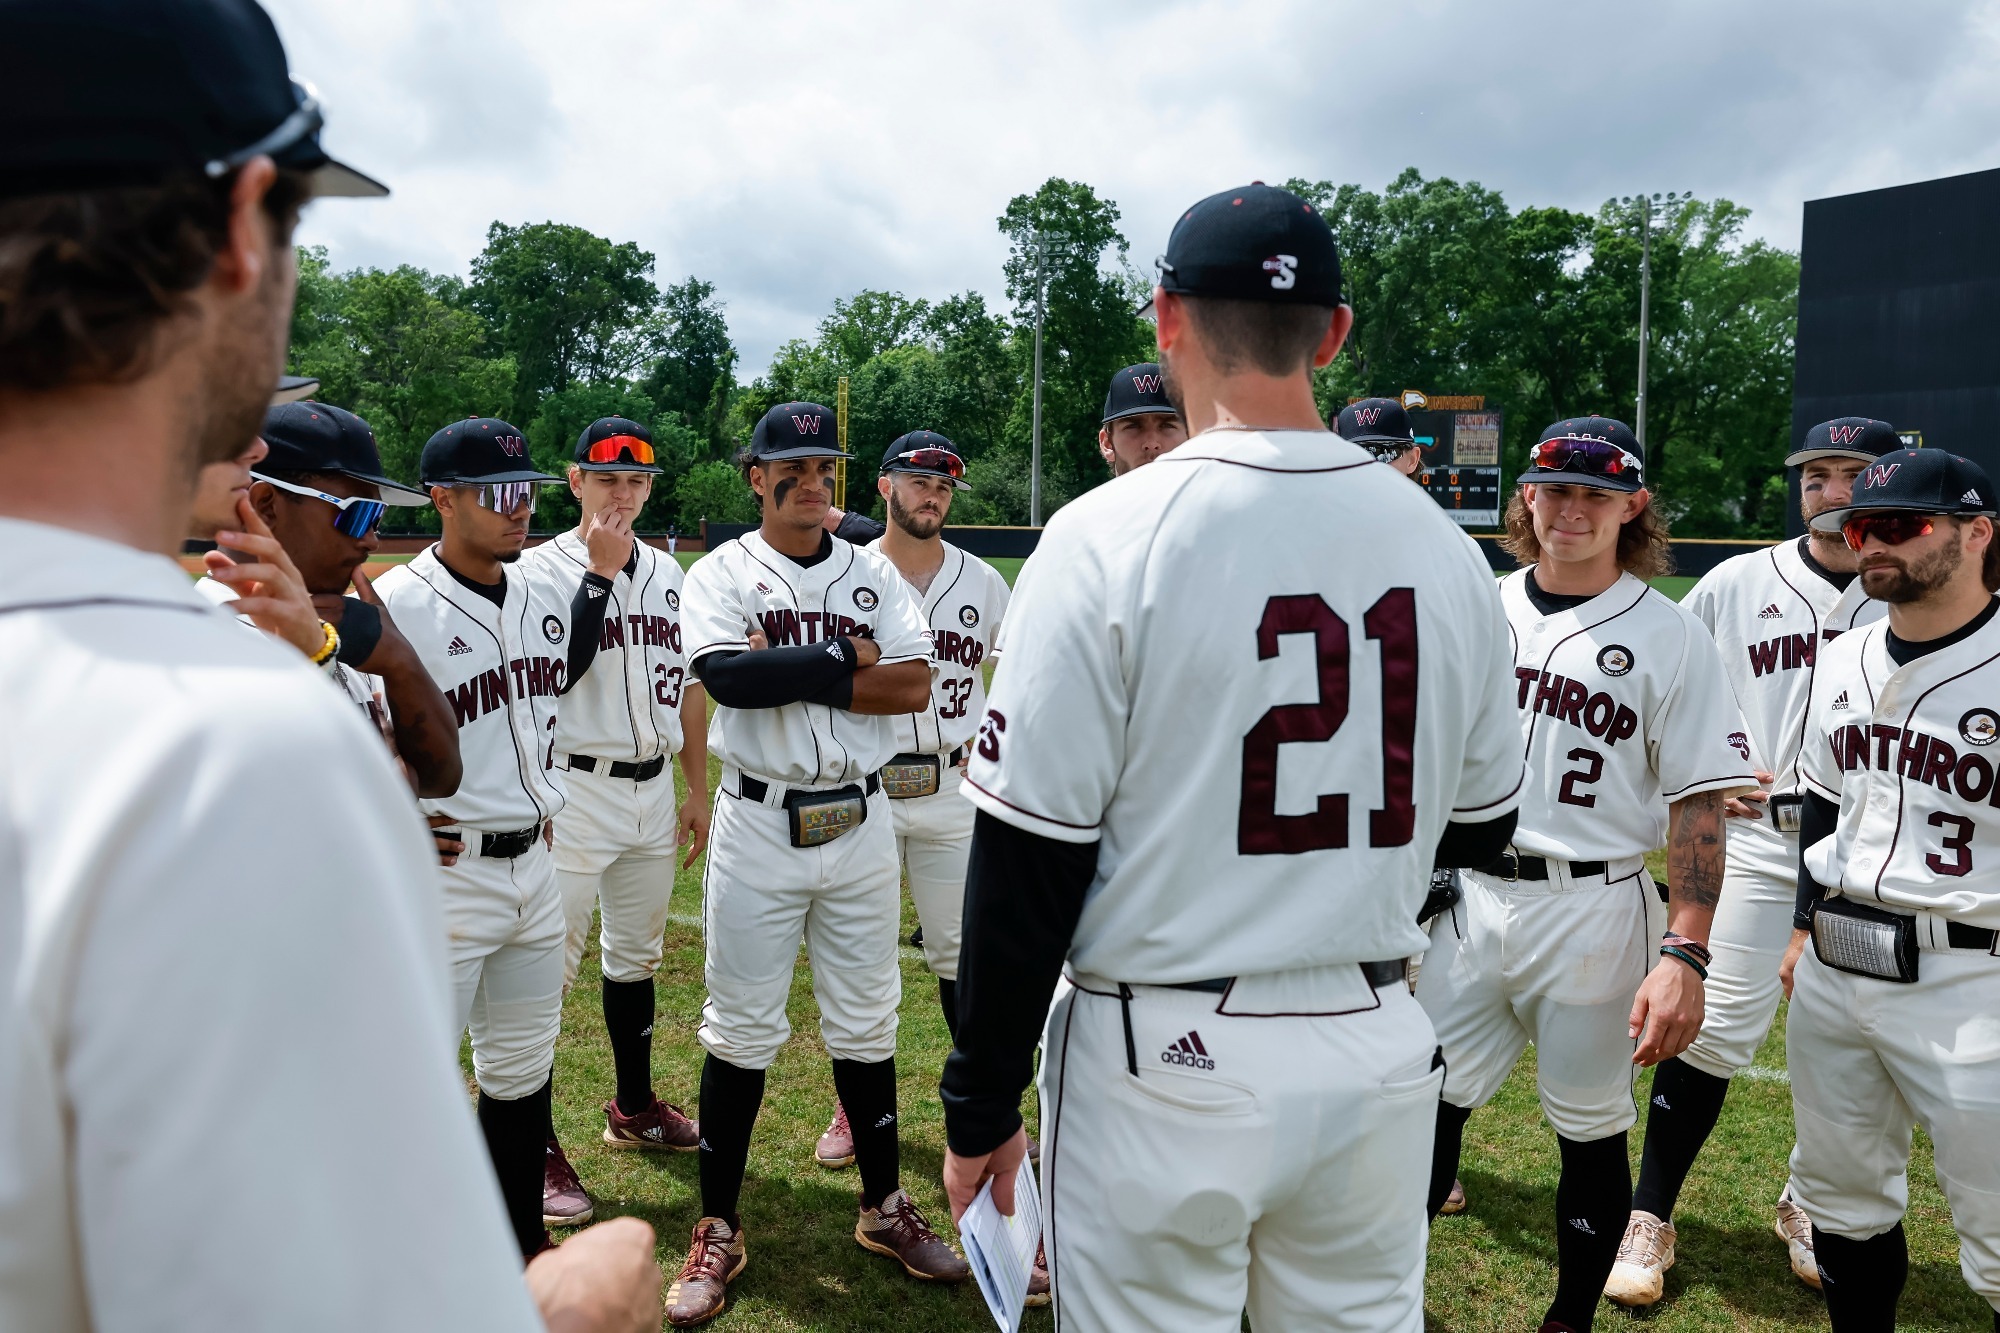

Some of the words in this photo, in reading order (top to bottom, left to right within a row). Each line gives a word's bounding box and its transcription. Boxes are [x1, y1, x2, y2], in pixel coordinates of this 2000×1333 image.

[1133, 375, 1162, 394] W
[1427, 395, 1485, 411] UNIVERSITY
[792, 414, 821, 435] W
[1354, 408, 1381, 426] W
[1829, 426, 1864, 444] W
[495, 435, 523, 457] W
[1422, 474, 1429, 485] 0
[1450, 474, 1458, 485] 0
[1864, 463, 1900, 489] W
[1961, 497, 1983, 506] adidas
[447, 646, 473, 656] adidas
[655, 662, 684, 708] 23
[939, 677, 974, 719] 32
[1238, 587, 1419, 855] 21
[1963, 734, 1979, 744] United
[1558, 747, 1604, 808] 2
[1926, 811, 1976, 877] 3
[1161, 1050, 1215, 1071] adidas
